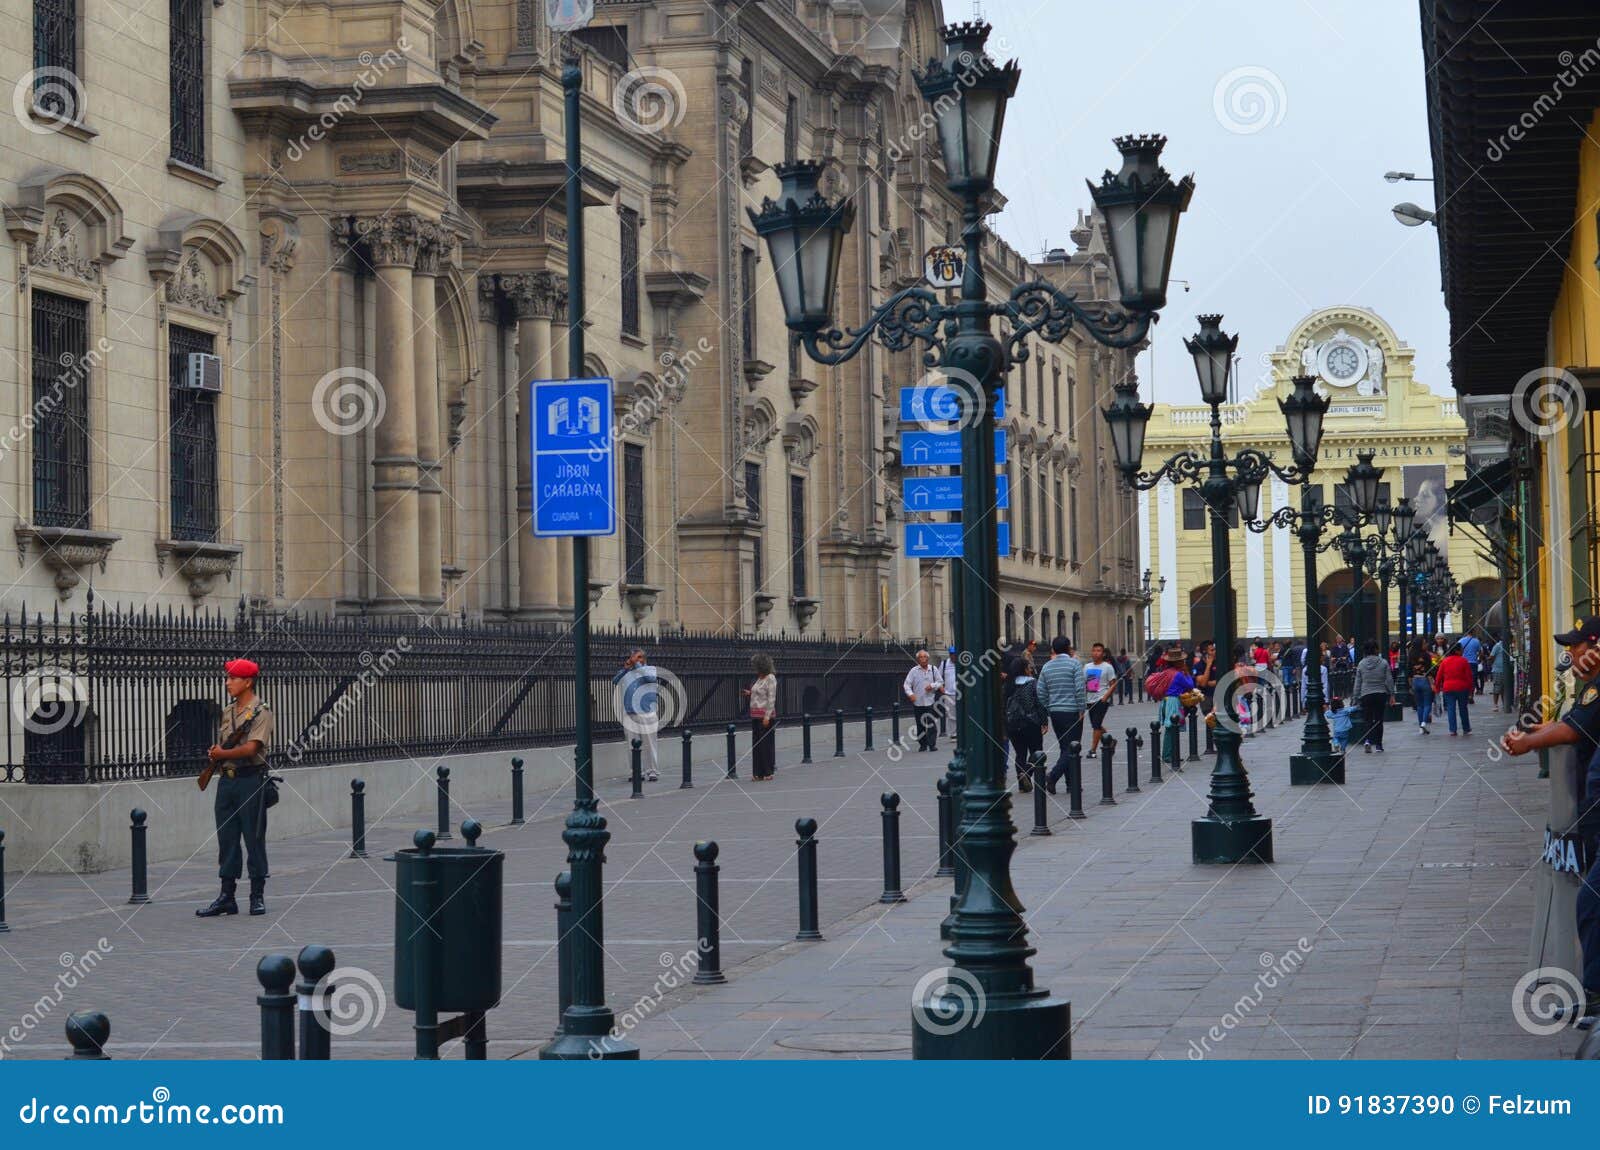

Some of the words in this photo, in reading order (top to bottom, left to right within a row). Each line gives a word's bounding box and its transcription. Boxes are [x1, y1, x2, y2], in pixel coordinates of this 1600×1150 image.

[1325, 446, 1433, 458] LITERATURA
[544, 483, 603, 498] CARABAYA
[552, 512, 580, 522] CUADRA
